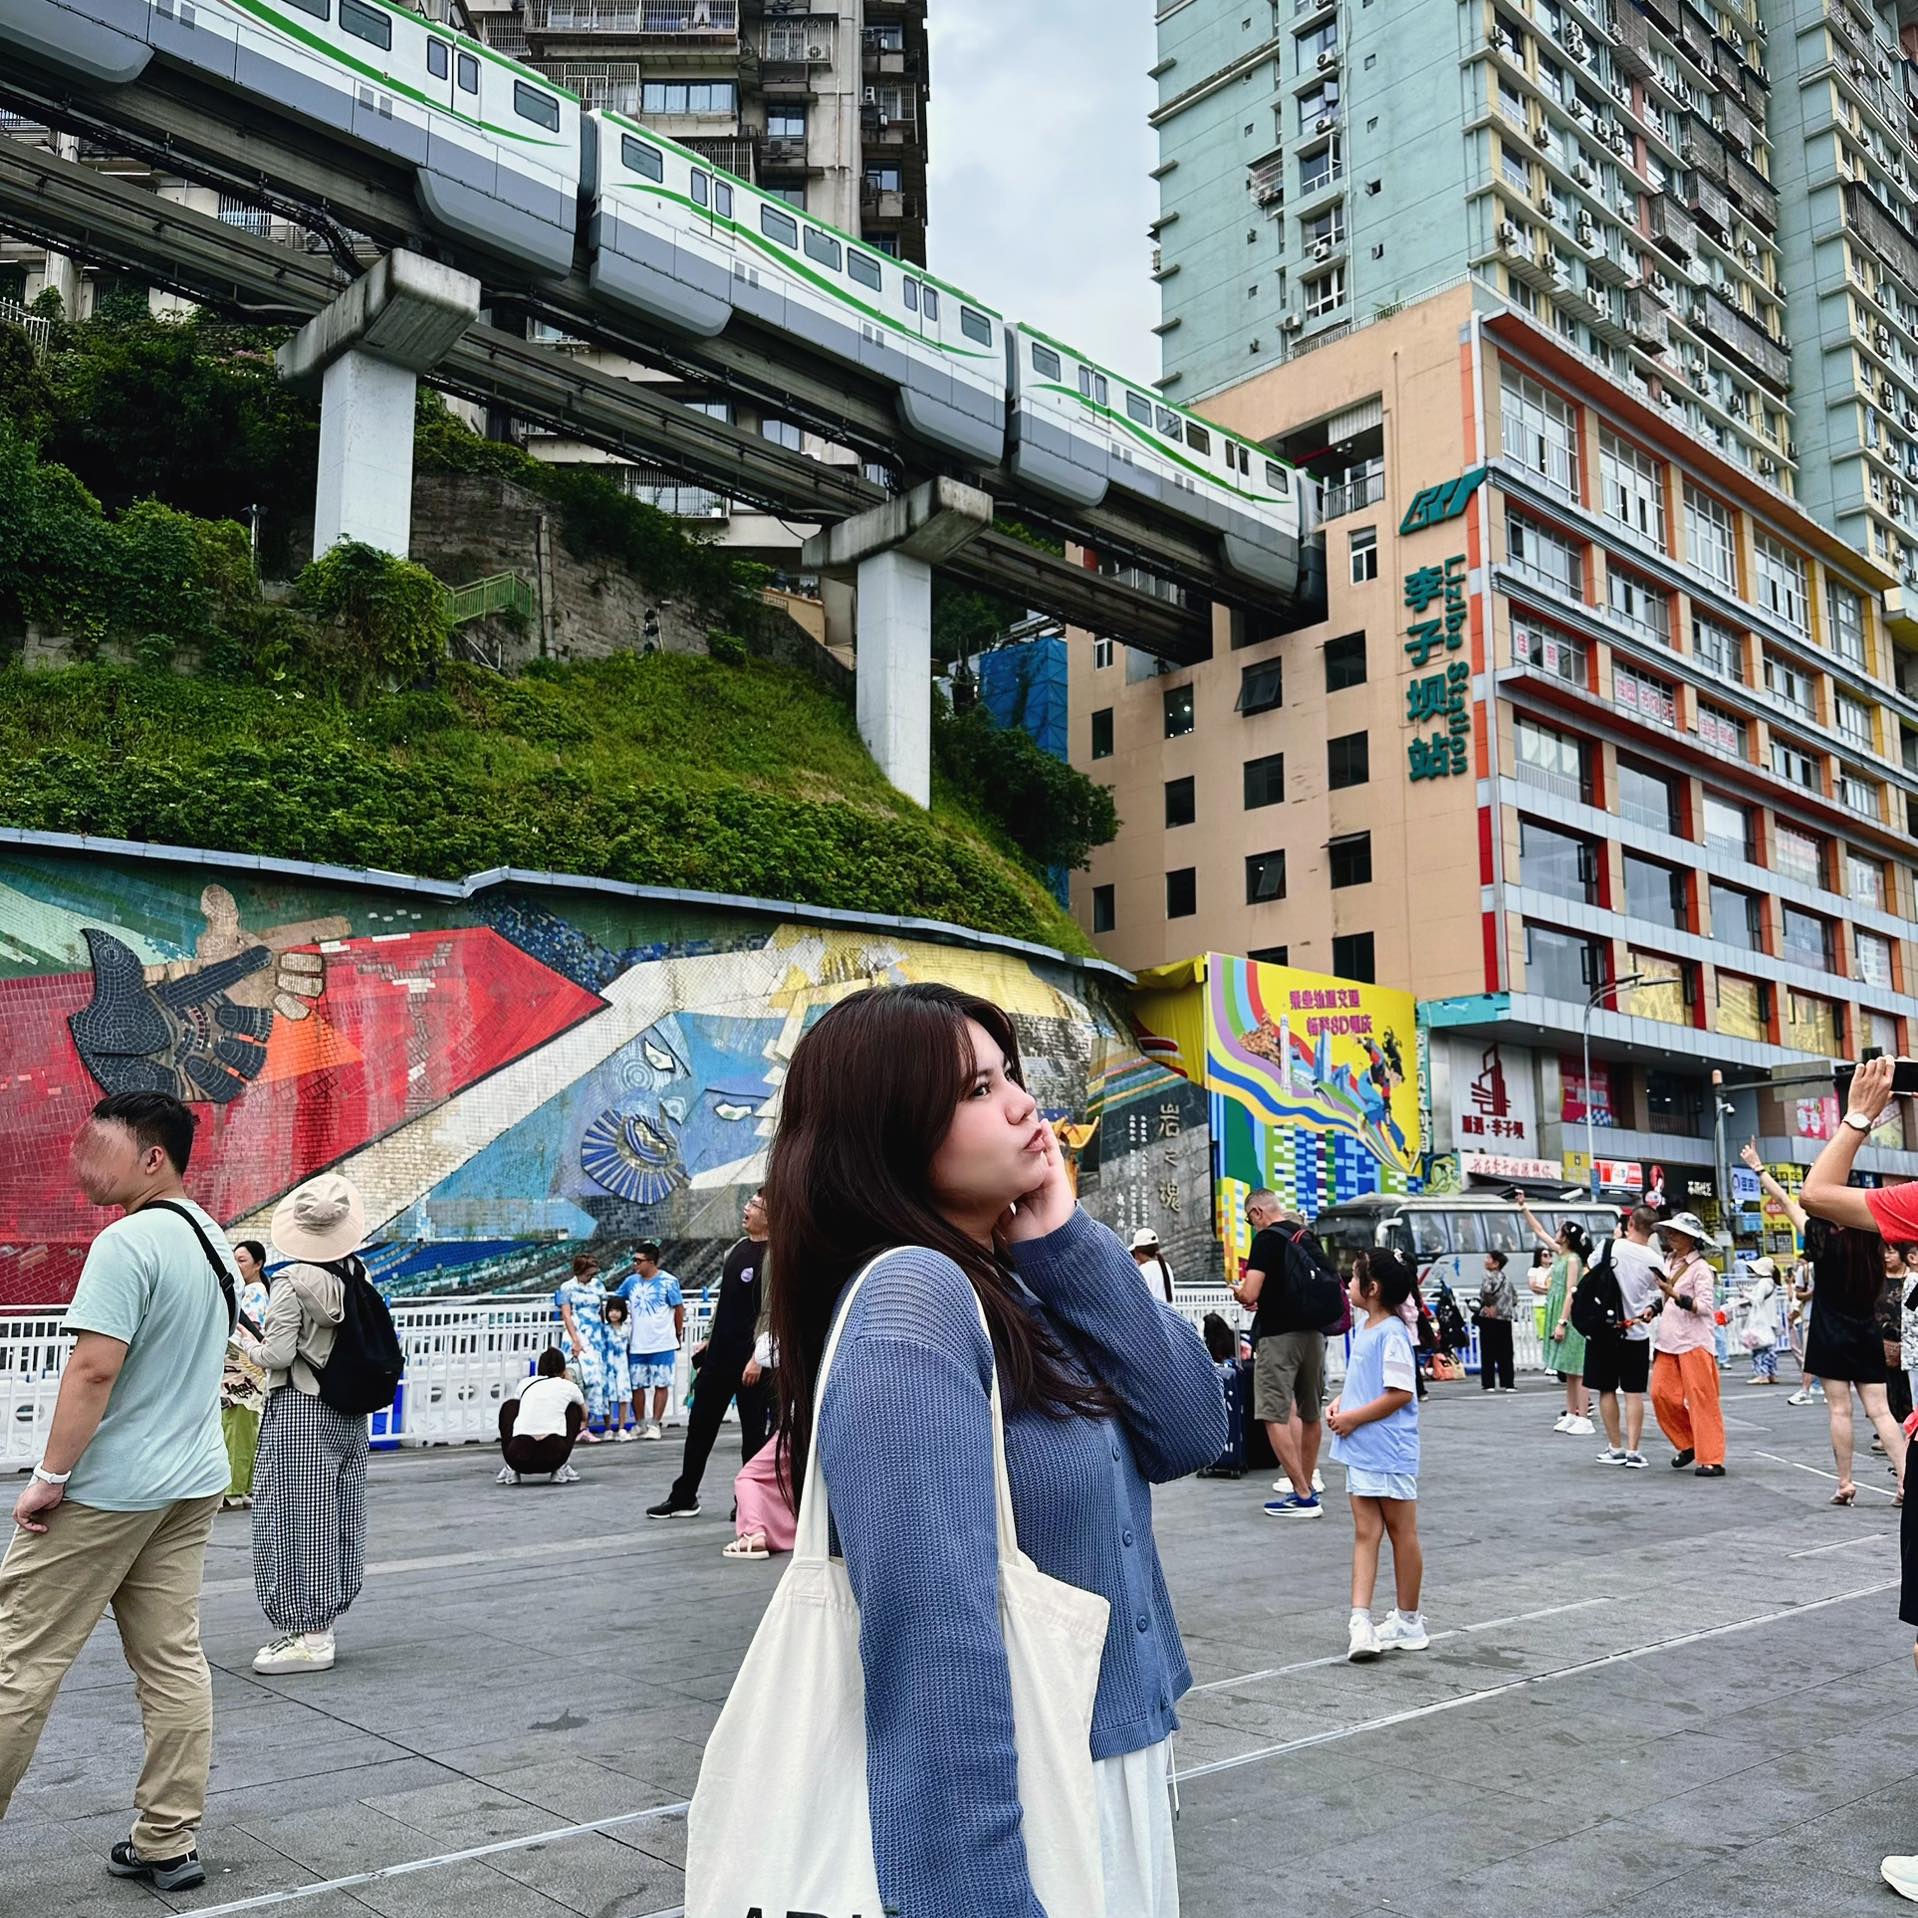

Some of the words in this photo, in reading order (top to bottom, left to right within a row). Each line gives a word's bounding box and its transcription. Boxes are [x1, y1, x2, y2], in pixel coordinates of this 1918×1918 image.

[1444, 553, 1467, 651] Liziba
[1404, 565, 1450, 783] 李子坝站
[1447, 661, 1471, 776] Station
[1159, 1103, 1180, 1212] 岩之魂
